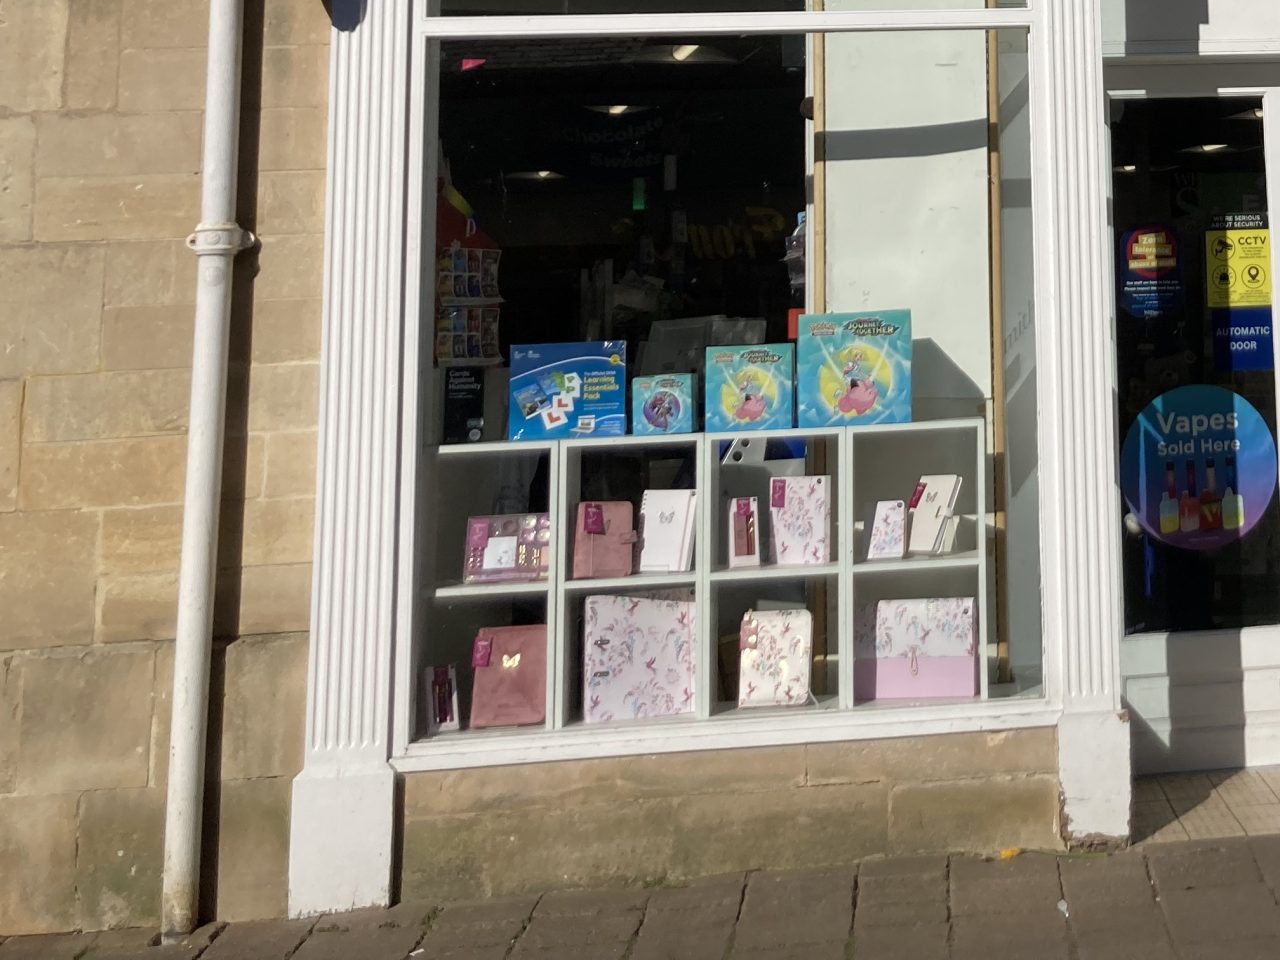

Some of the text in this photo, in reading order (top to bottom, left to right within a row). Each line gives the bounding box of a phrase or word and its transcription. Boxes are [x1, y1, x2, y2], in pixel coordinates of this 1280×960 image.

[1238, 236, 1266, 246] CCTV
[1216, 326, 1270, 336] AUTOMATIC
[1230, 340, 1257, 350] DOOR
[1156, 412, 1239, 436] Vapes
[1157, 438, 1240, 456] Sold Here
